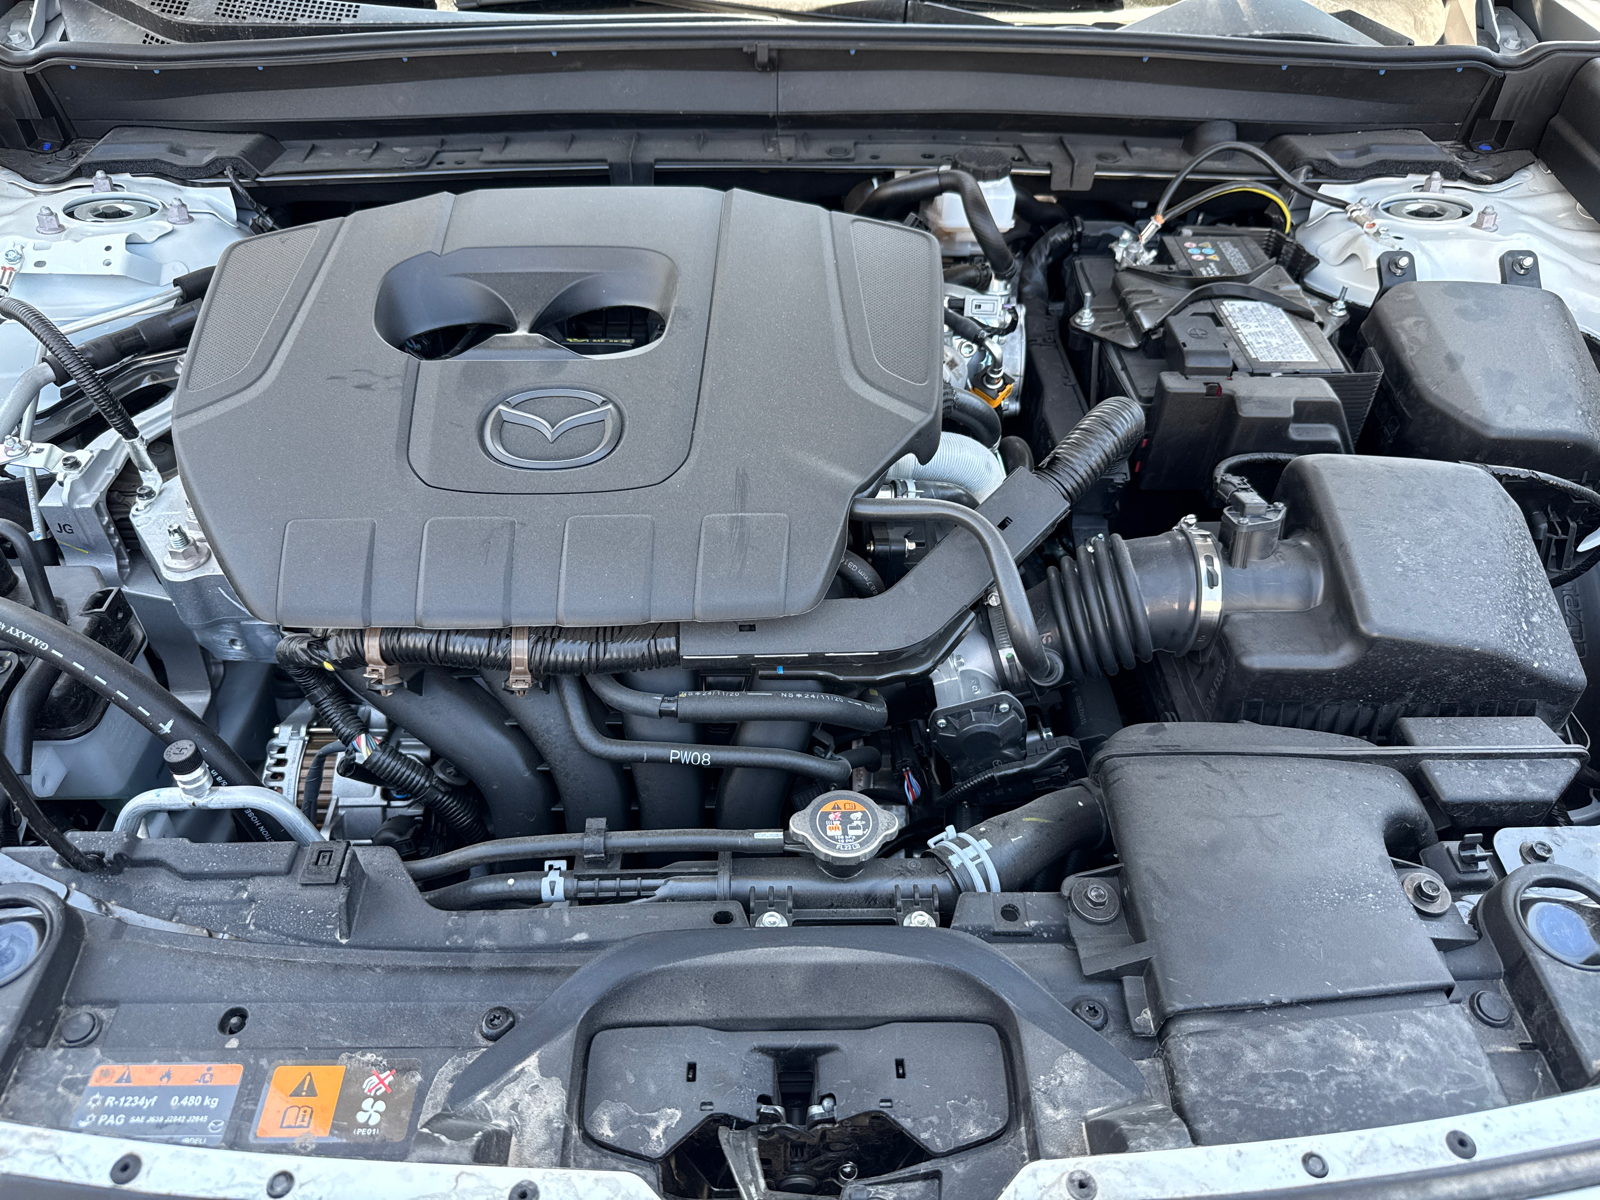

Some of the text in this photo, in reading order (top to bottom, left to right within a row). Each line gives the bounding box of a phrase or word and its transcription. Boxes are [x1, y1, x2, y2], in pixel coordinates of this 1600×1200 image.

[56, 522, 74, 534] JG
[5, 626, 49, 650] GALAXY
[669, 749, 711, 766] PW08
[244, 808, 262, 827] HOSE
[104, 1095, 219, 1109] R-1234yf 0.480 kg
[97, 1114, 125, 1125] PAG
[129, 1115, 145, 1123] SAE
